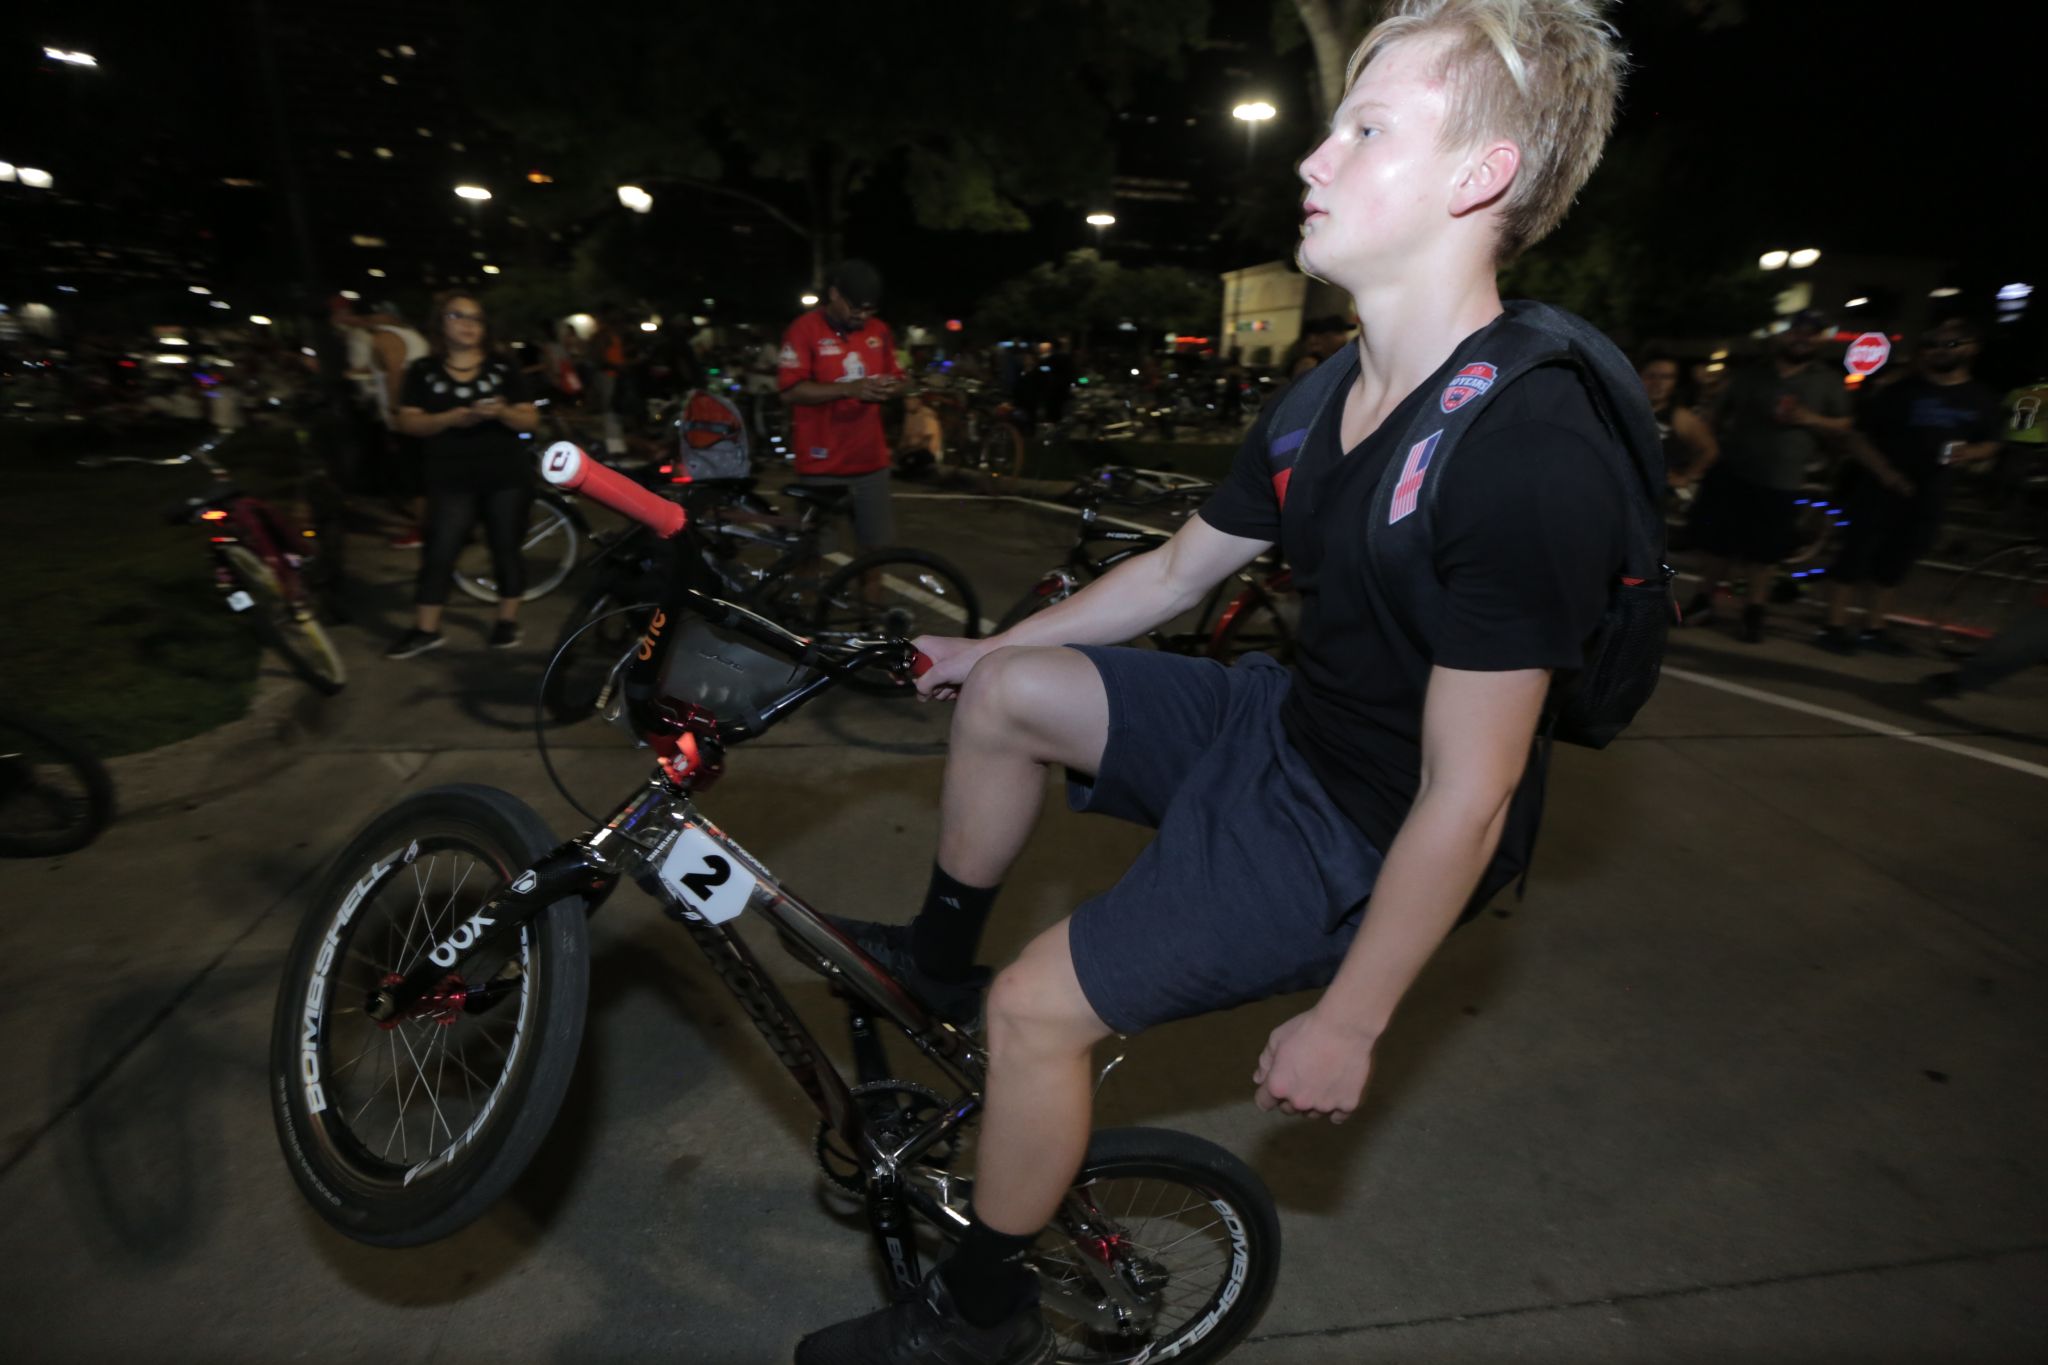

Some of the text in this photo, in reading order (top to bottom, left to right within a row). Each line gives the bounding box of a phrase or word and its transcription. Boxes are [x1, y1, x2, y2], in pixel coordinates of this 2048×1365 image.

[1848, 345, 1887, 362] STOP
[680, 855, 731, 902] 2
[301, 861, 391, 1115] BOMBSHELL
[1159, 1199, 1250, 1357] BOMBSHELL
